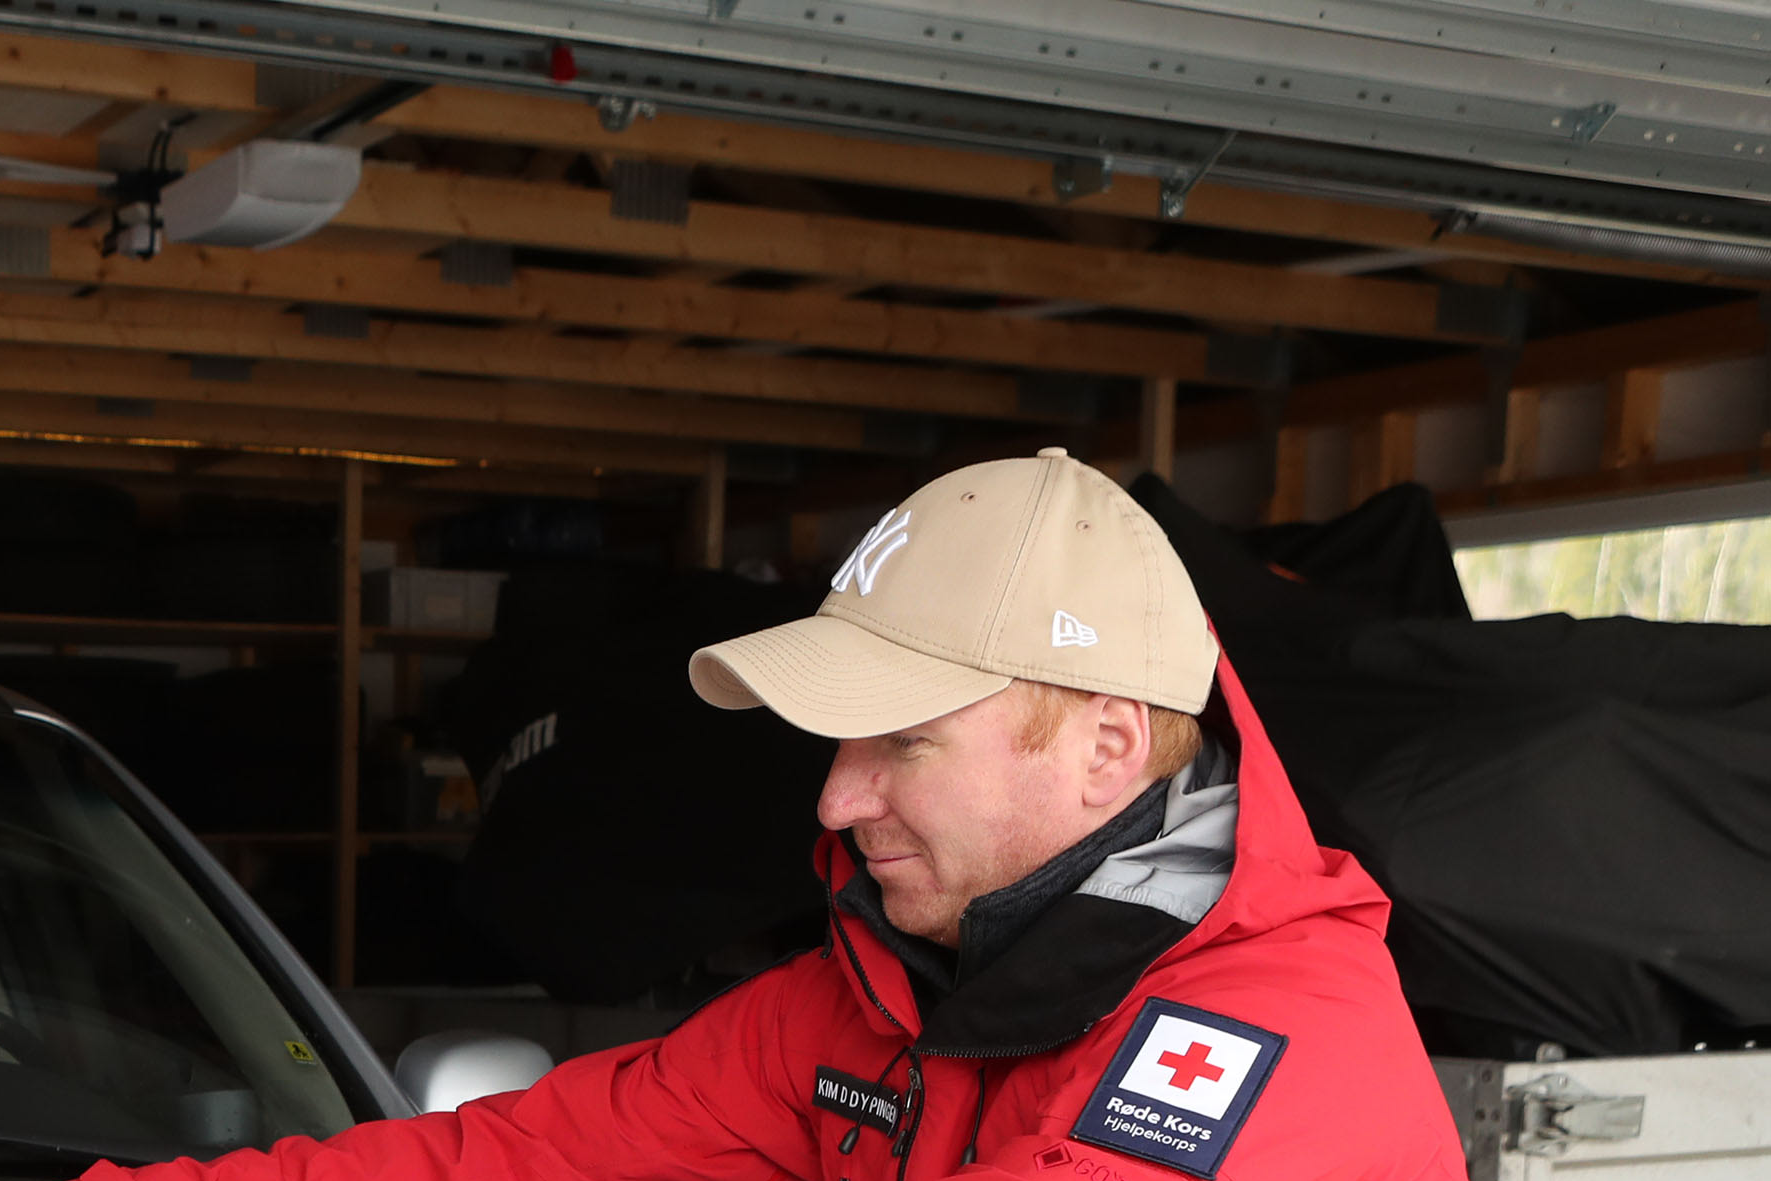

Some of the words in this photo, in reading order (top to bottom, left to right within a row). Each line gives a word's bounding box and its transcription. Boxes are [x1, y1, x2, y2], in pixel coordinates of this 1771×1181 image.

[818, 1078, 839, 1101] KIM
[1103, 1115, 1197, 1153] Hjelpekorps
[1106, 1096, 1161, 1125] Røde
[1162, 1113, 1212, 1141] Kors
